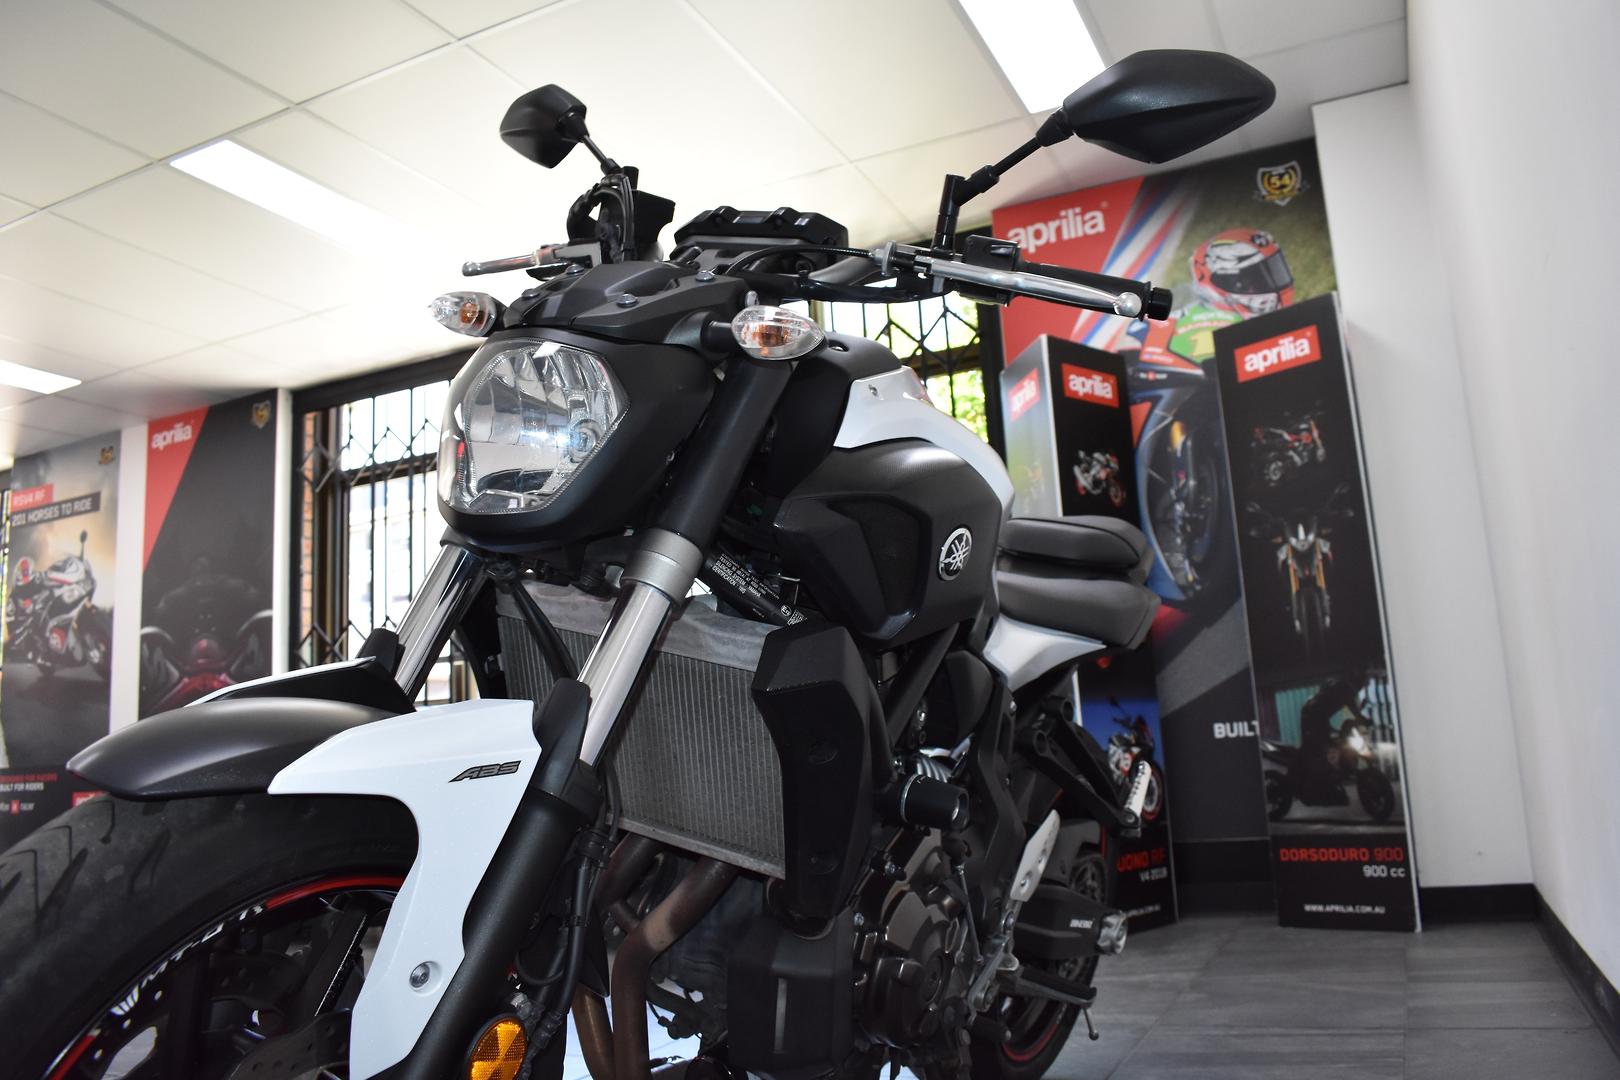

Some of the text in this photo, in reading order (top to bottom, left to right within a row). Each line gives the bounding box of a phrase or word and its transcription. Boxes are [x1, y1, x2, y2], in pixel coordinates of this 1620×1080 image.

[1008, 207, 1105, 253] aprilia
[1244, 336, 1310, 372] aprilia
[1068, 374, 1113, 399] aprilia
[152, 422, 193, 450] aprilia
[27, 505, 60, 522] HORSES
[61, 501, 72, 515] TO
[73, 497, 92, 513] RIDE
[1213, 720, 1260, 739] BUILT
[448, 760, 521, 783] ABS
[1279, 848, 1404, 862] DORSODURO 900
[1363, 865, 1405, 877] 900 cc
